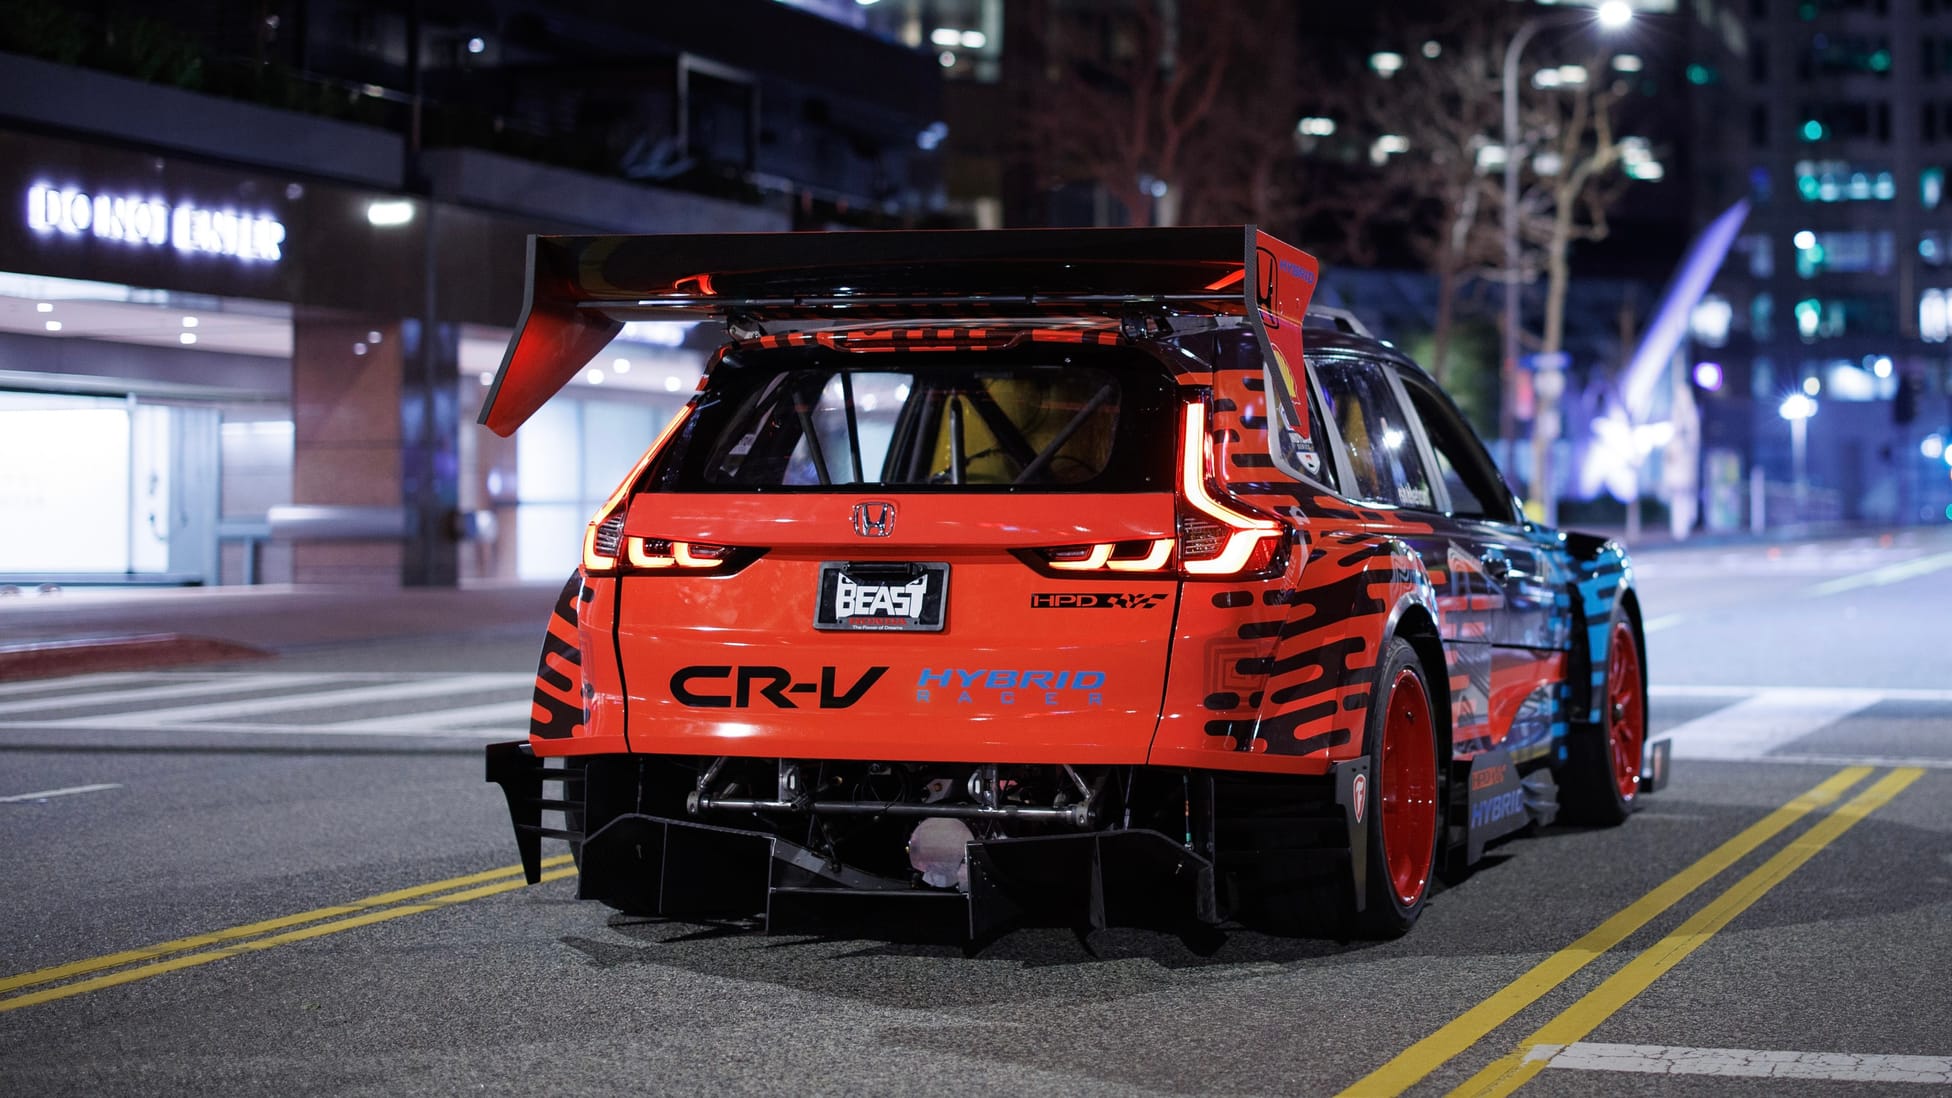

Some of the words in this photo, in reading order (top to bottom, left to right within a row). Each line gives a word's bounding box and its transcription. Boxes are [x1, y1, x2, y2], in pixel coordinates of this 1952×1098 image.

[28, 185, 91, 232] DO
[92, 194, 169, 246] NOT
[172, 204, 286, 261] ENTER
[1279, 259, 1315, 285] HYBRID
[835, 572, 929, 620] BEAST
[1032, 594, 1099, 608] HPD
[669, 665, 890, 709] CR-V
[917, 667, 1106, 690] HYBRID
[916, 690, 1103, 706] RACER
